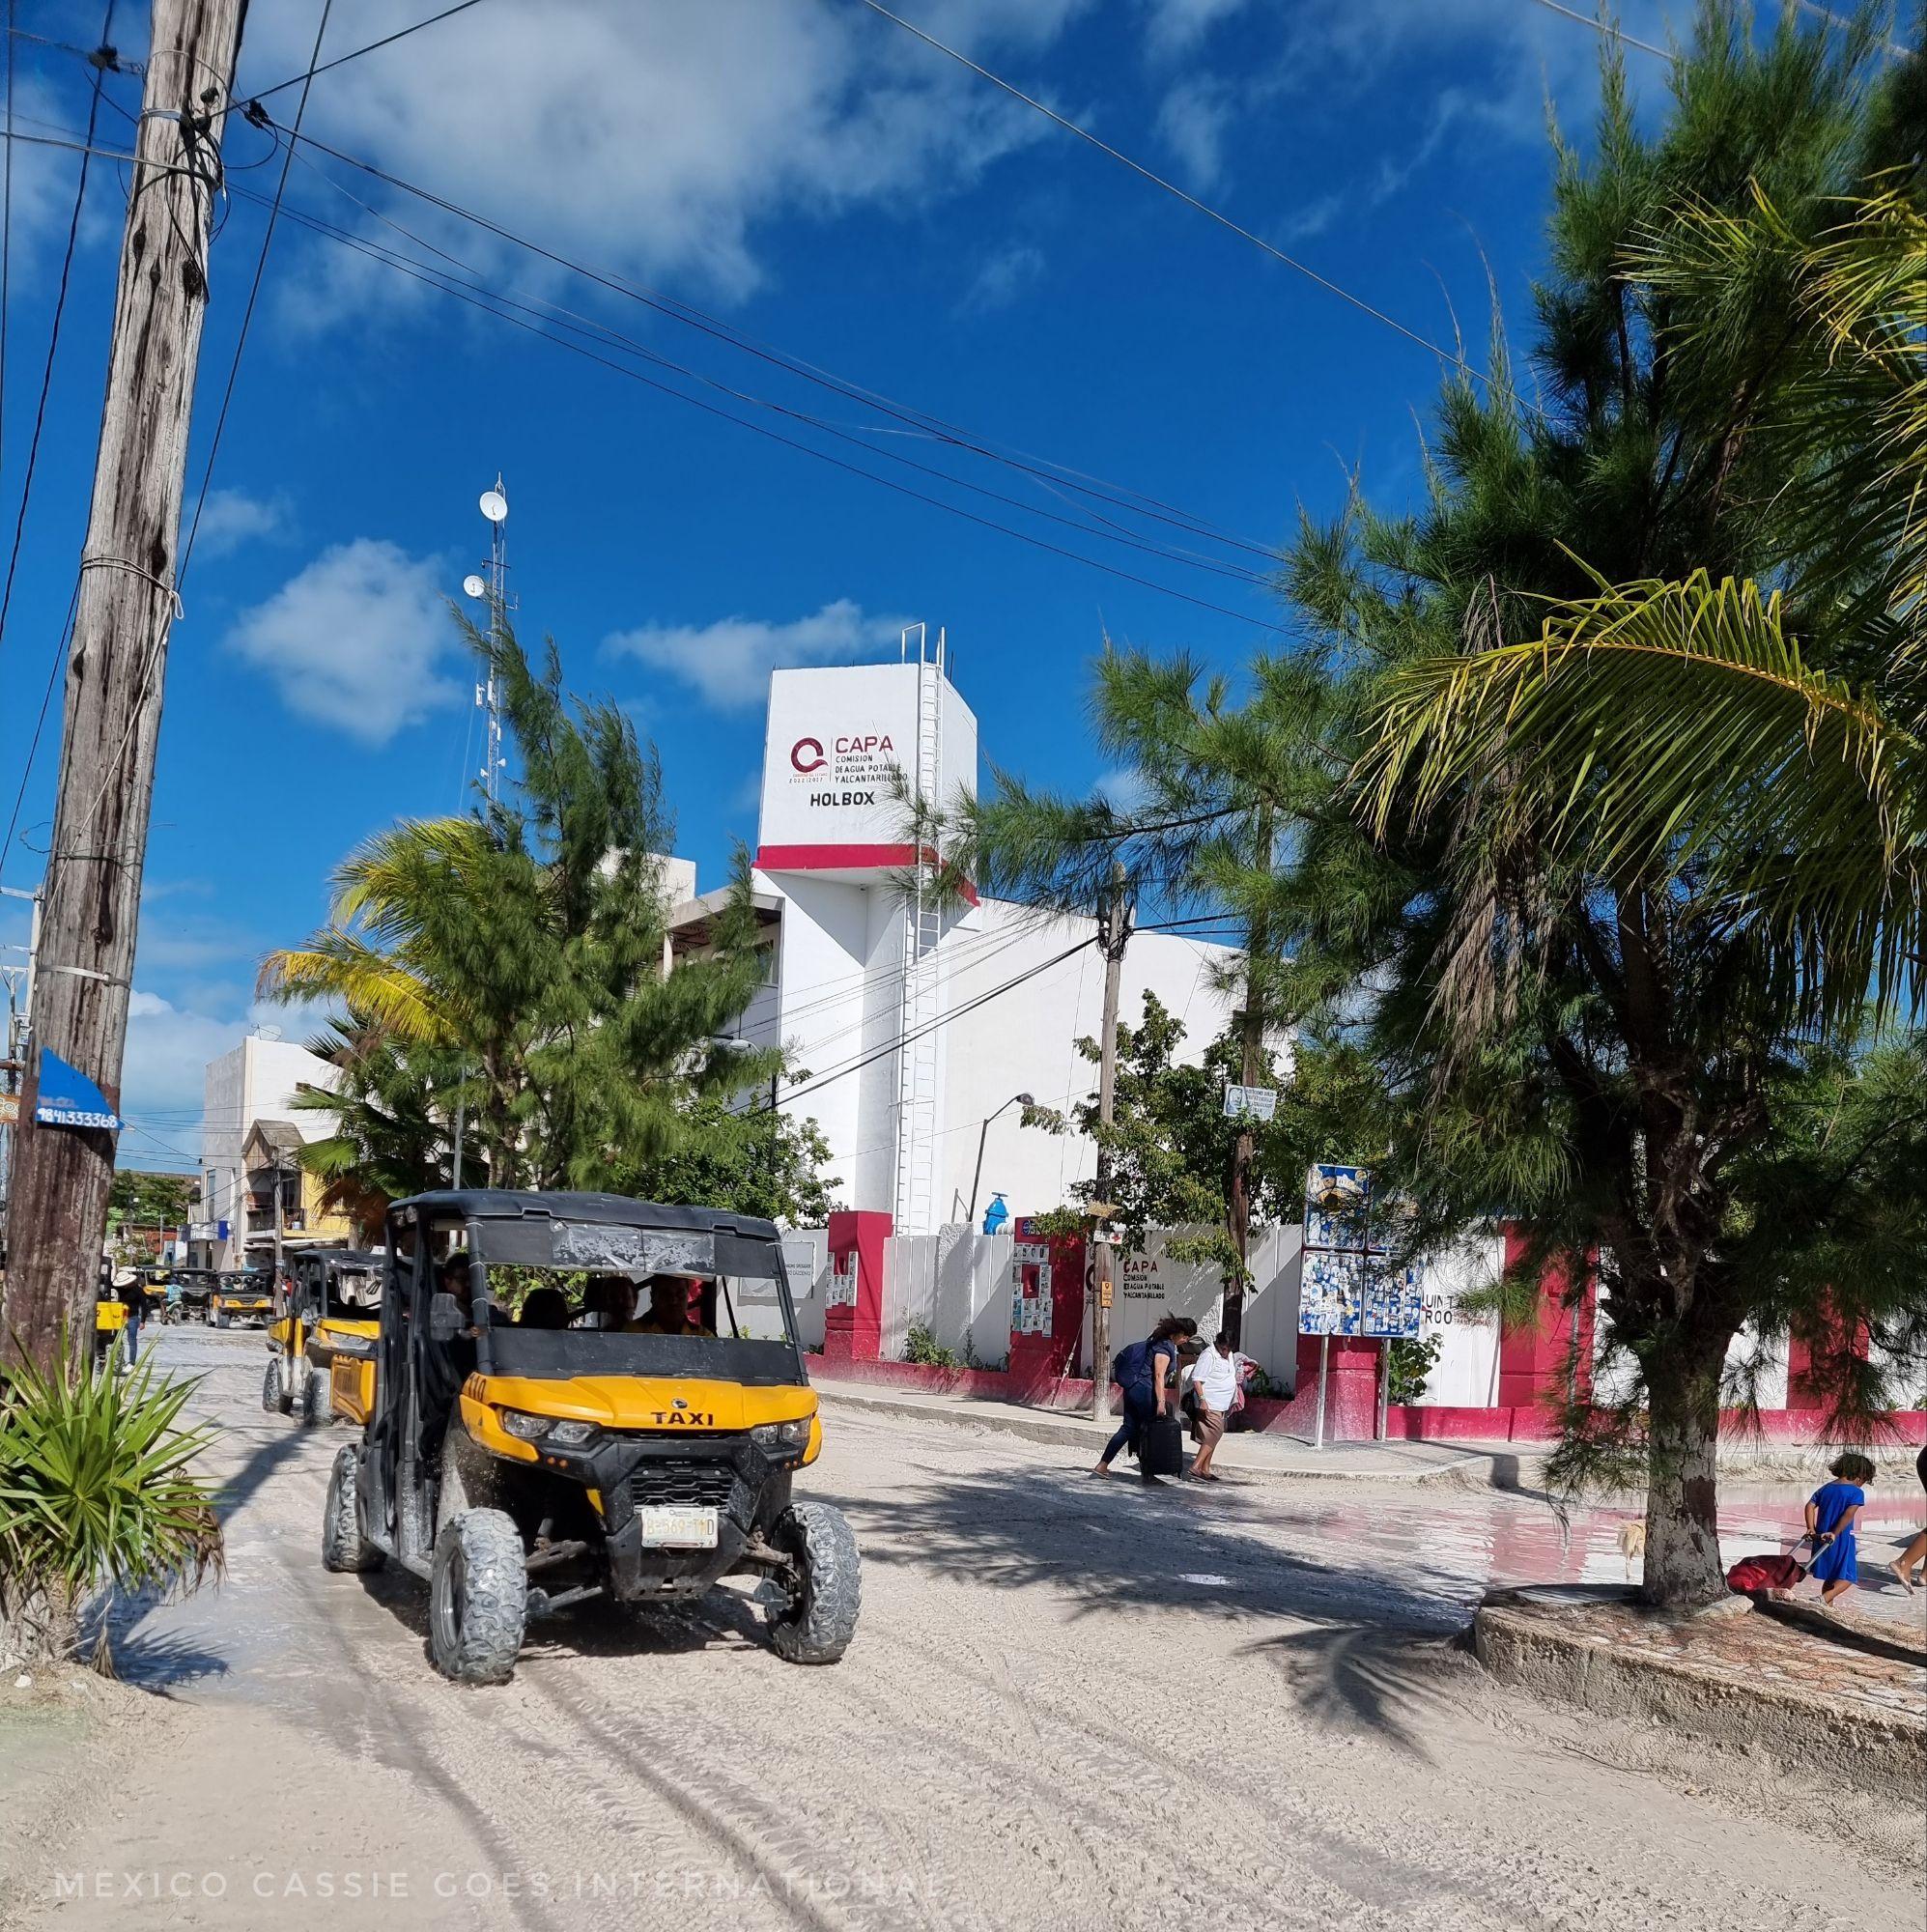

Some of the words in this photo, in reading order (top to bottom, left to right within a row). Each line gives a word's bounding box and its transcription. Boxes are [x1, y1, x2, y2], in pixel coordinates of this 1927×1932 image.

[836, 735, 893, 753] CAPA
[844, 764, 865, 773] AGUA
[868, 763, 901, 772] POTABLE
[840, 773, 908, 783] ALCANTARILLADO
[810, 791, 875, 807] HOLBOX
[37, 1108, 118, 1128] 9841333368
[1123, 1260, 1158, 1273] CAPA
[1425, 1310, 1453, 1324] ROO
[650, 1411, 714, 1426] TAXI
